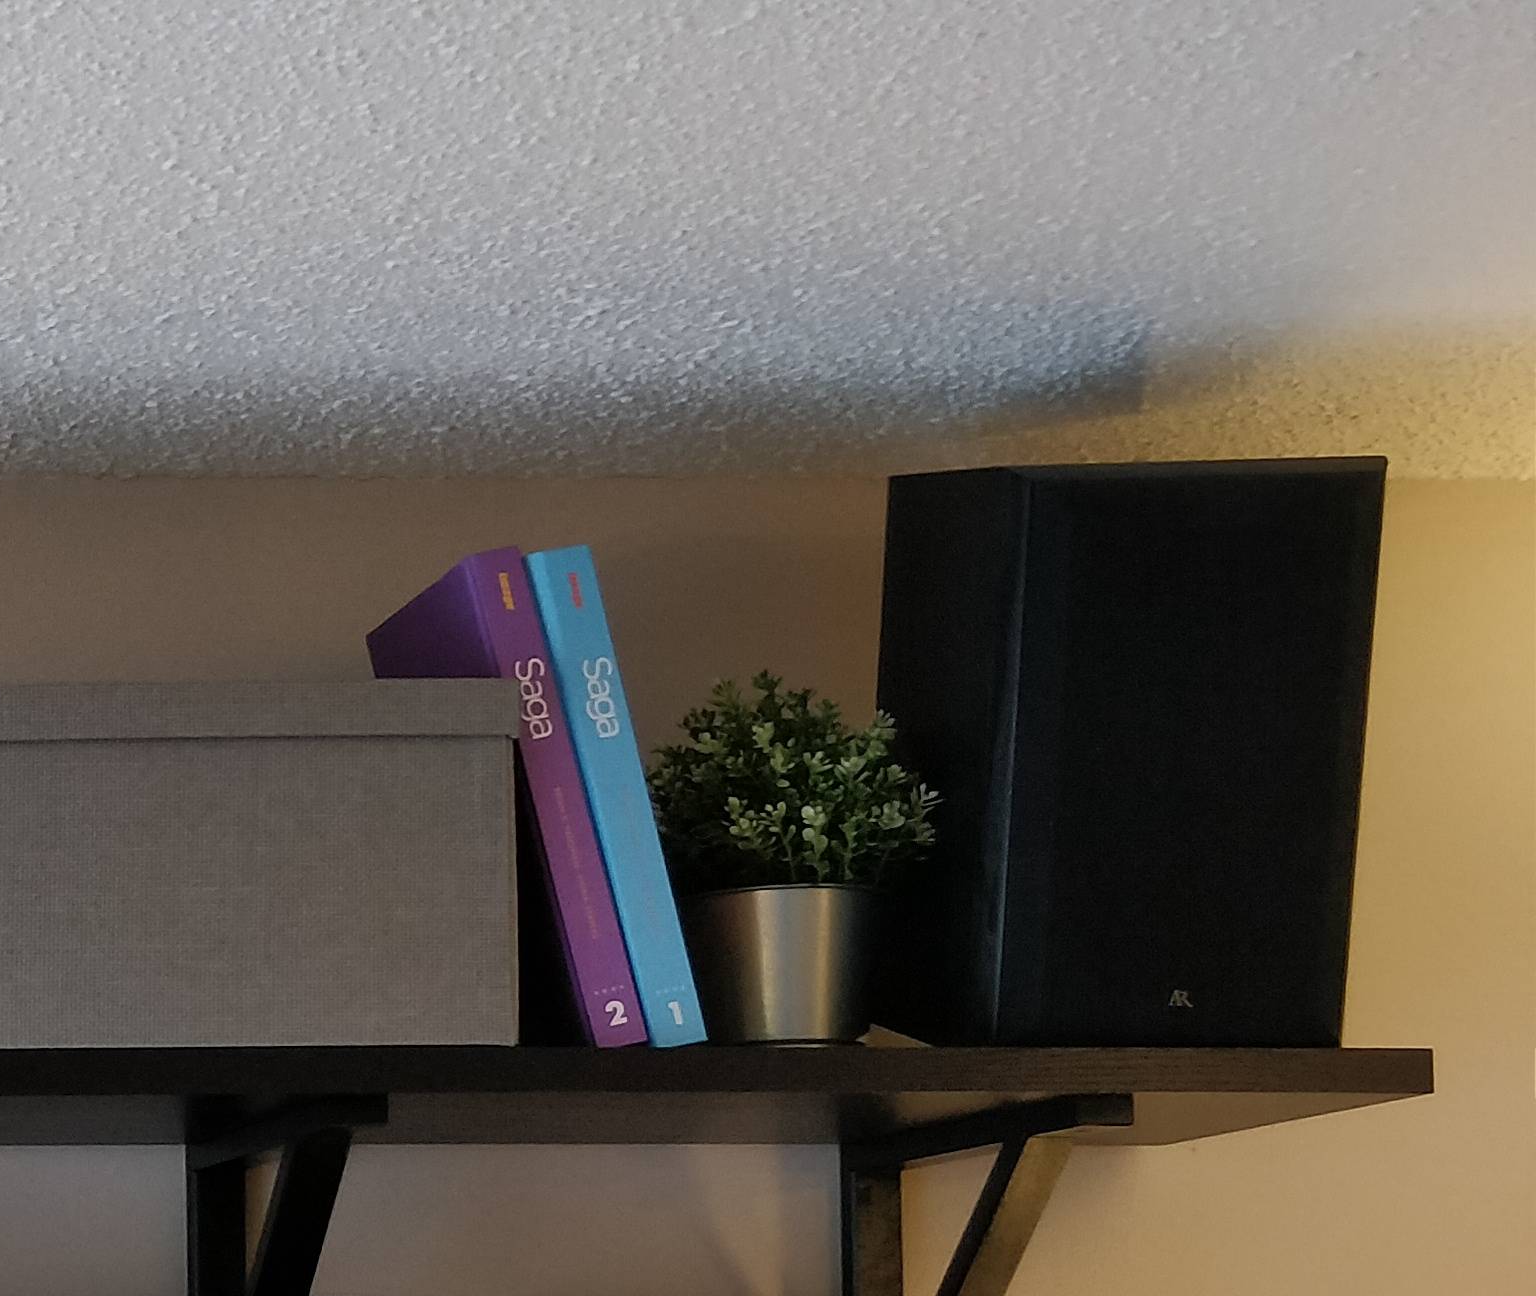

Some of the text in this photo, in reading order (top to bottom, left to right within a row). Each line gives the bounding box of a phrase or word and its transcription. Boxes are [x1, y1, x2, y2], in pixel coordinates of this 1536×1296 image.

[516, 658, 552, 739] Saga
[584, 657, 620, 738] Saga
[605, 1001, 627, 1026] 2
[668, 1002, 683, 1024] 1
